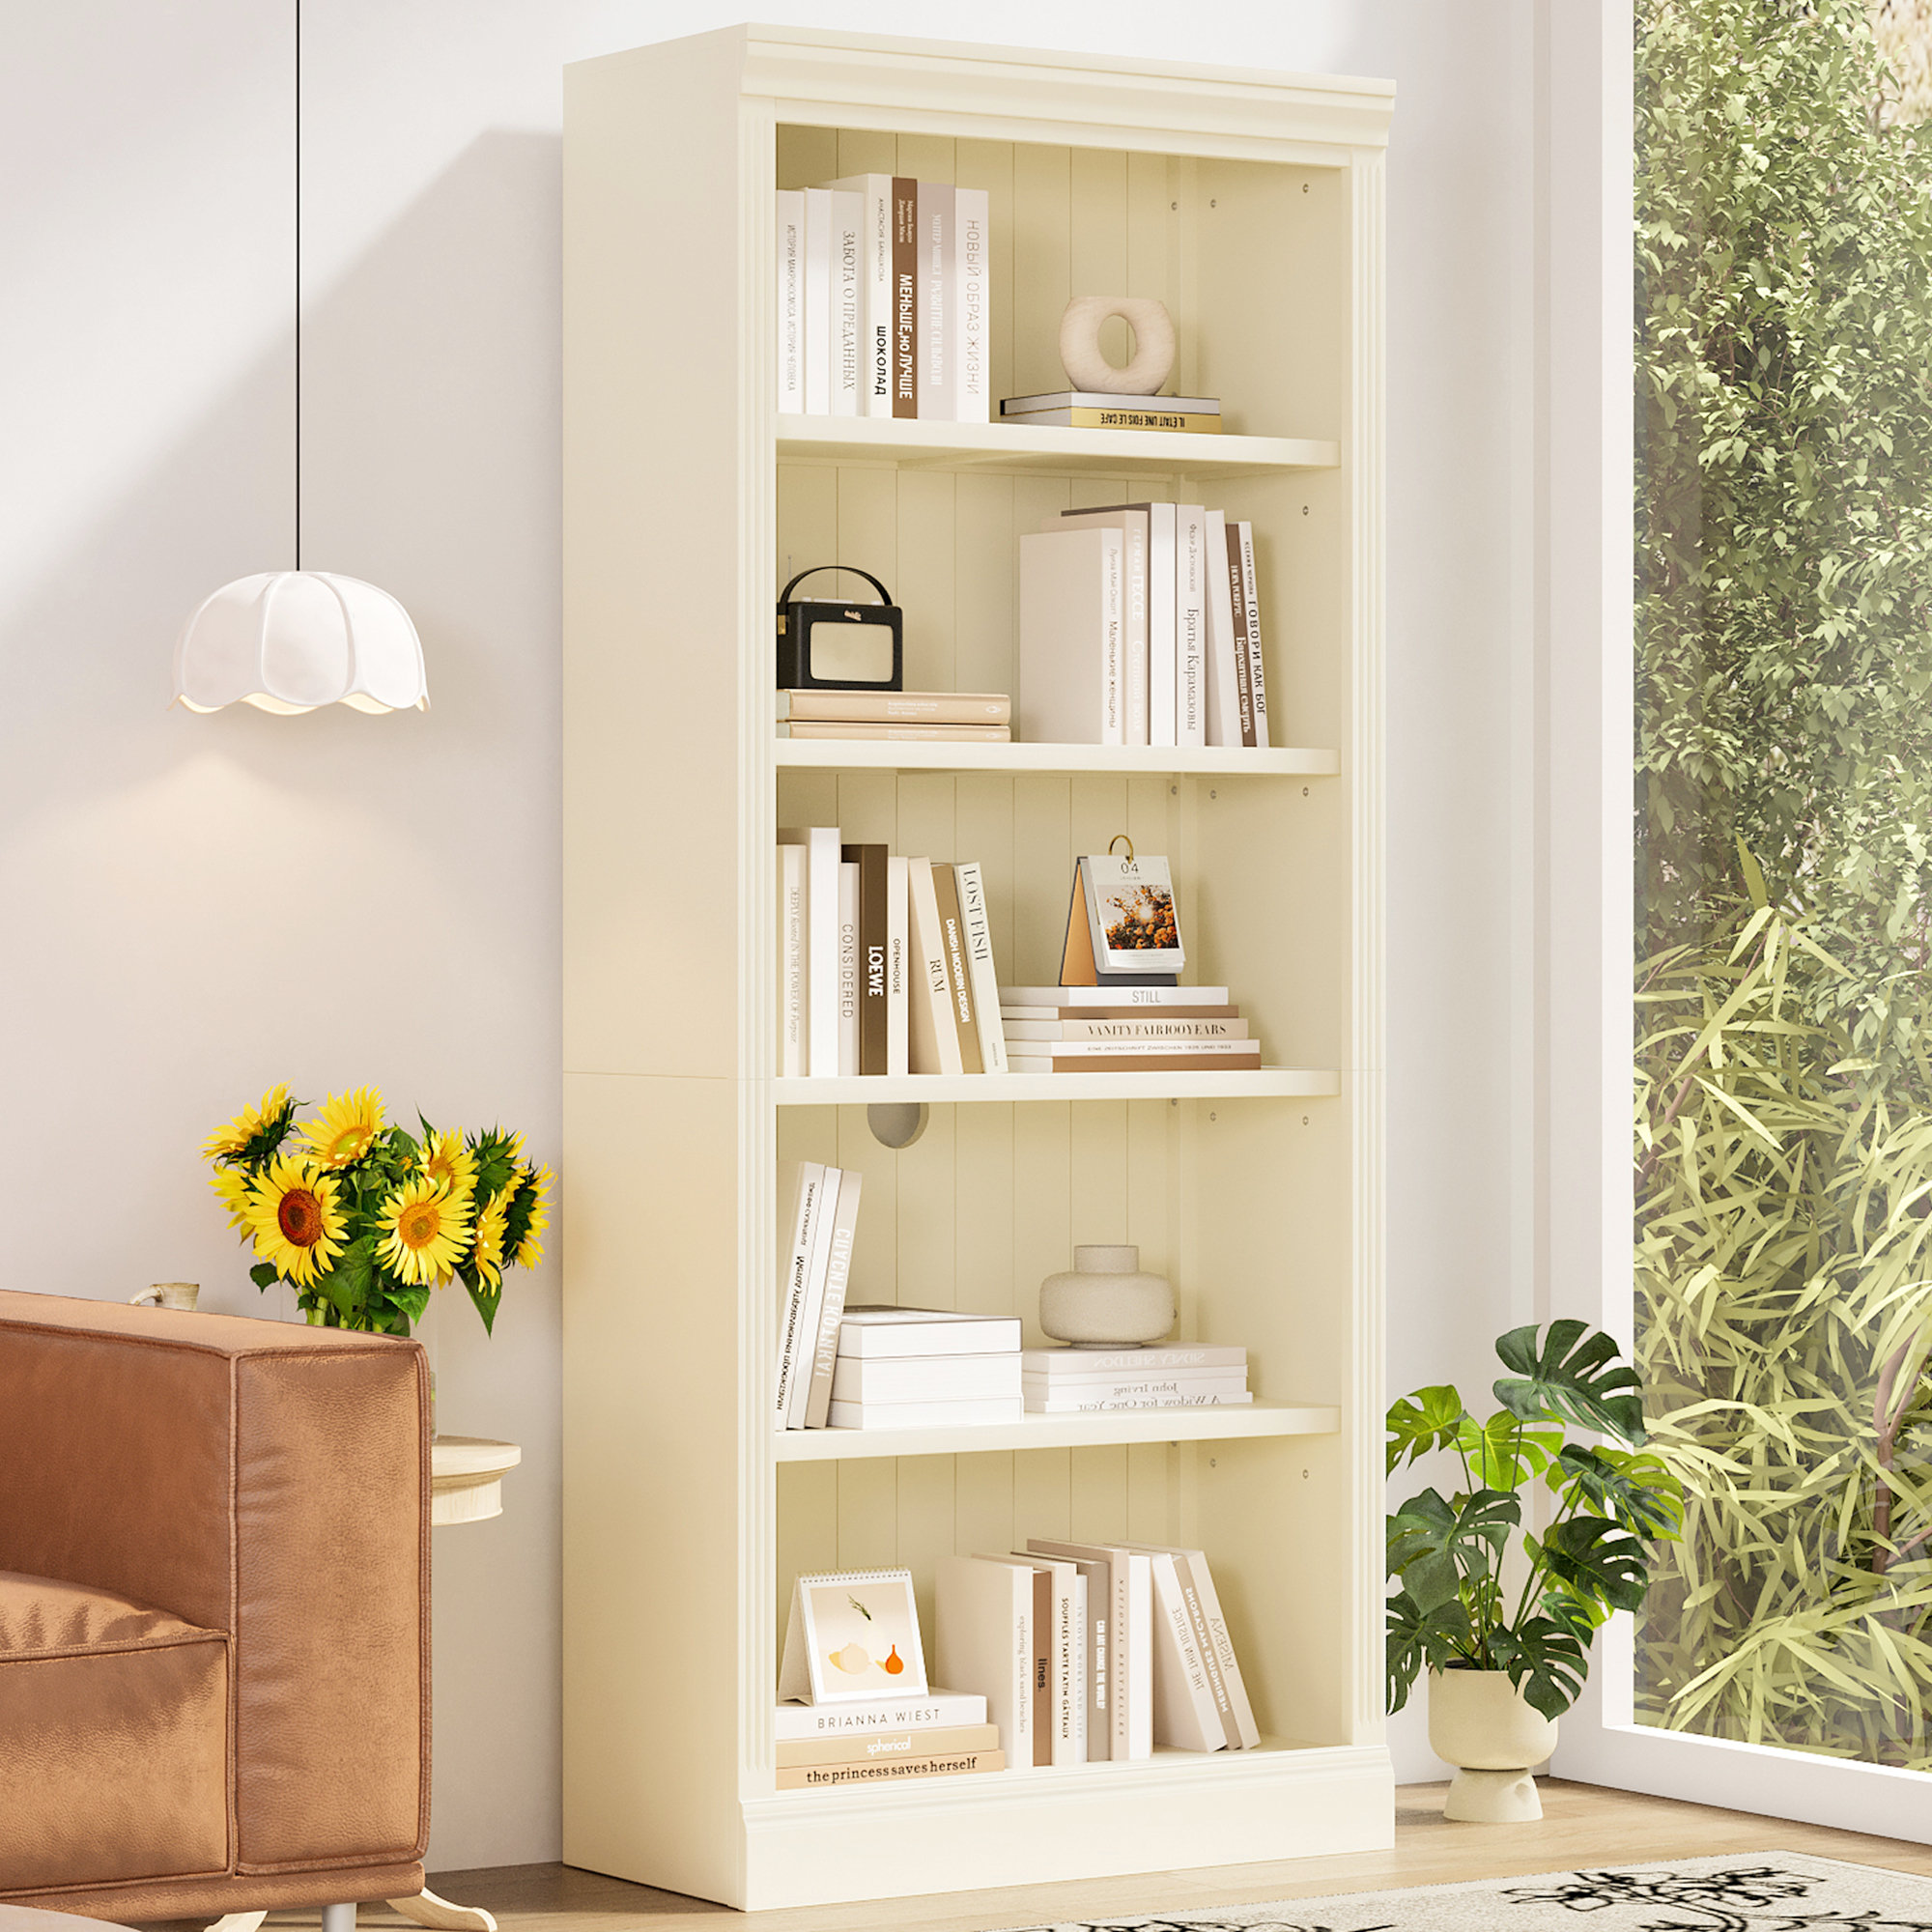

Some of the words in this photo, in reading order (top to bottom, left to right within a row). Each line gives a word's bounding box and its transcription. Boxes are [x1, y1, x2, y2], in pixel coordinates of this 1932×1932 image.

[842, 231, 856, 282] ЗАБОТА
[966, 219, 981, 277] НОВЫЙ
[842, 288, 856, 298] О
[966, 282, 980, 332] ОБРАЗ
[841, 301, 856, 390] ПРЕДАННЫХ
[874, 326, 887, 395] ШОКОЛАД
[899, 353, 913, 399] ЛУЧШЕ
[966, 336, 980, 395] ЖИЗНИ
[1119, 413, 1127, 425] LE
[1128, 414, 1144, 426] FOIS
[1145, 415, 1157, 427] UNE
[1131, 576, 1145, 621] ГЕССЕ
[1108, 620, 1119, 677] Маленькие
[1184, 609, 1200, 652] Братья
[1248, 601, 1261, 660] ГОВОРИ
[1235, 637, 1249, 695] Бархатная
[1253, 665, 1263, 688] КАК
[1108, 679, 1117, 727] женщины
[1183, 655, 1200, 730] Карамазовы
[1255, 694, 1265, 715] БОГ
[1240, 696, 1252, 733] смерть
[1121, 862, 1139, 874] 04
[790, 887, 800, 916] DEEPLY
[964, 869, 982, 916] LOST
[946, 918, 959, 952] DANISH
[970, 920, 988, 960] FISH
[842, 923, 854, 1018] CONSIDERED
[868, 946, 884, 997] LOEWE
[930, 959, 946, 993] RUM
[952, 952, 965, 990] MODERN
[957, 990, 971, 1023] DESIGN
[1132, 990, 1161, 1004] STILL
[1088, 1024, 1131, 1036] VANITY
[817, 1714, 888, 1729] BRIANNA
[895, 1709, 940, 1722] WIEST
[867, 1736, 912, 1756] spherical
[807, 1770, 830, 1783] the
[831, 1767, 890, 1784] princess
[891, 1763, 928, 1776] saves
[929, 1757, 978, 1773] herself
